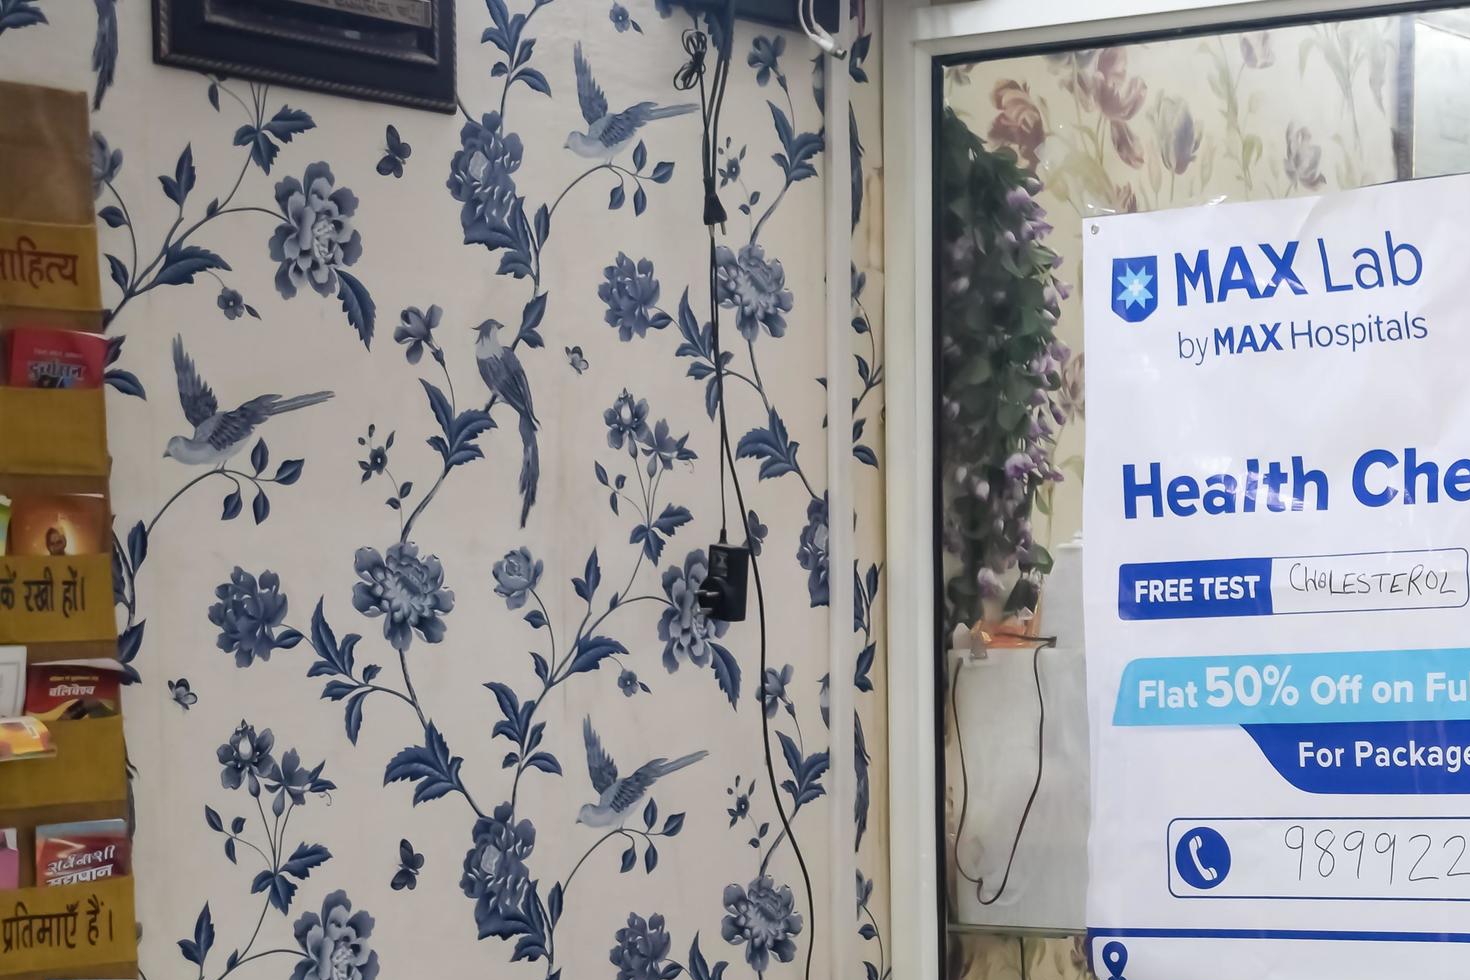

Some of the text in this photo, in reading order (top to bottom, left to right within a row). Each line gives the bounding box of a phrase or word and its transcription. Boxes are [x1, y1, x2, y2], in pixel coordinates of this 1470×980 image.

[1174, 230, 1423, 307] MAX Lab
[1178, 311, 1428, 365] by MAX Hospitals
[1122, 455, 1329, 519] Health
[23, 568, 55, 612] रखी
[1135, 575, 1260, 604] FREE TEST
[1138, 679, 1199, 709] Flat
[1205, 664, 1299, 707] 50%
[1310, 673, 1363, 705] Off
[1372, 680, 1414, 704] on
[1299, 741, 1345, 768] For
